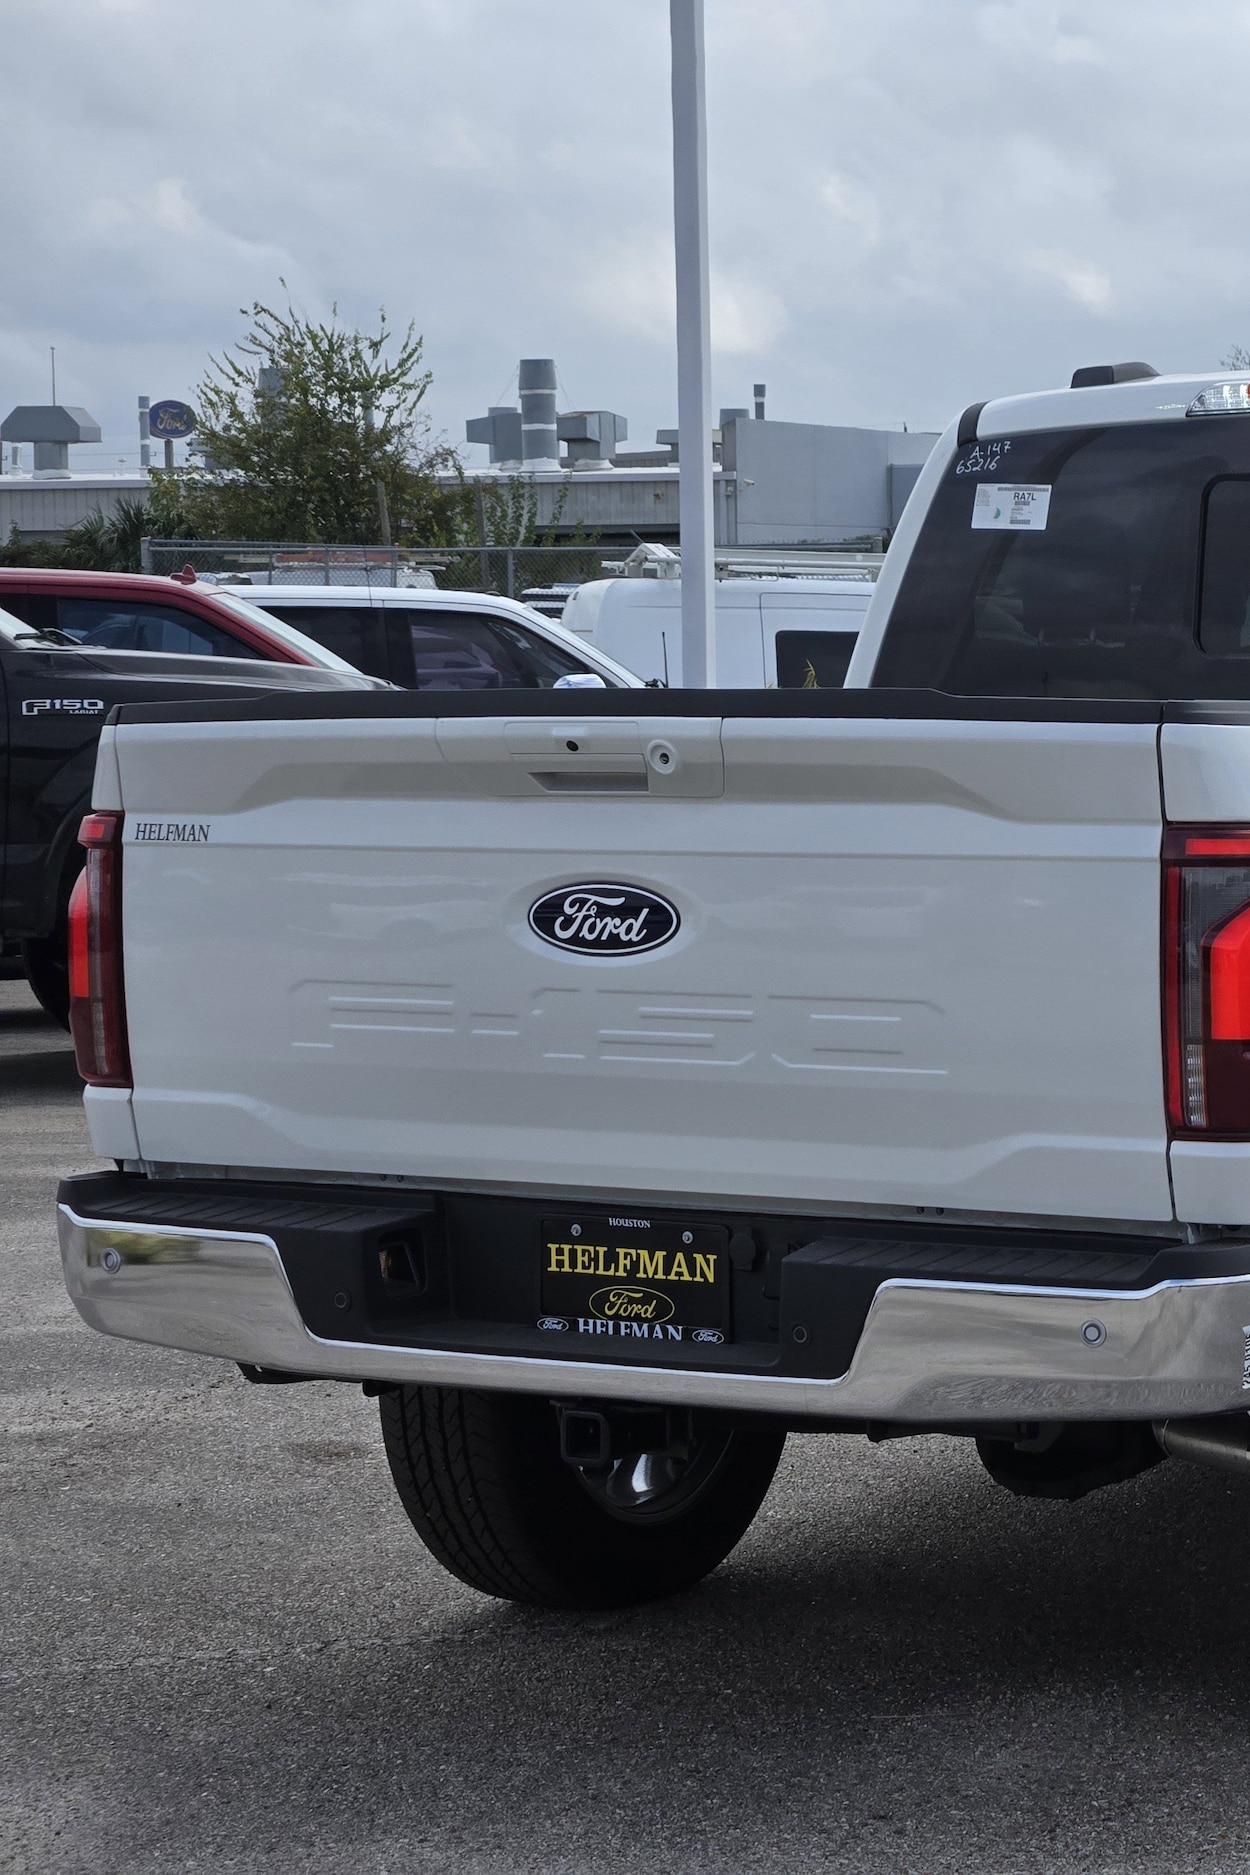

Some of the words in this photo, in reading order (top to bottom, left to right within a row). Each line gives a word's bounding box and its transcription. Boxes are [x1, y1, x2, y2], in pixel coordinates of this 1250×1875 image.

[956, 456, 1000, 474] 65216
[1013, 492, 1036, 501] RA7L
[135, 823, 211, 842] HELFMAN
[554, 893, 650, 942] Ford
[609, 1217, 651, 1229] HOUSTON
[547, 1243, 717, 1283] HELFMAN
[604, 1289, 657, 1319] Ford
[543, 1319, 564, 1331] Ford
[697, 1331, 718, 1343] Ford
